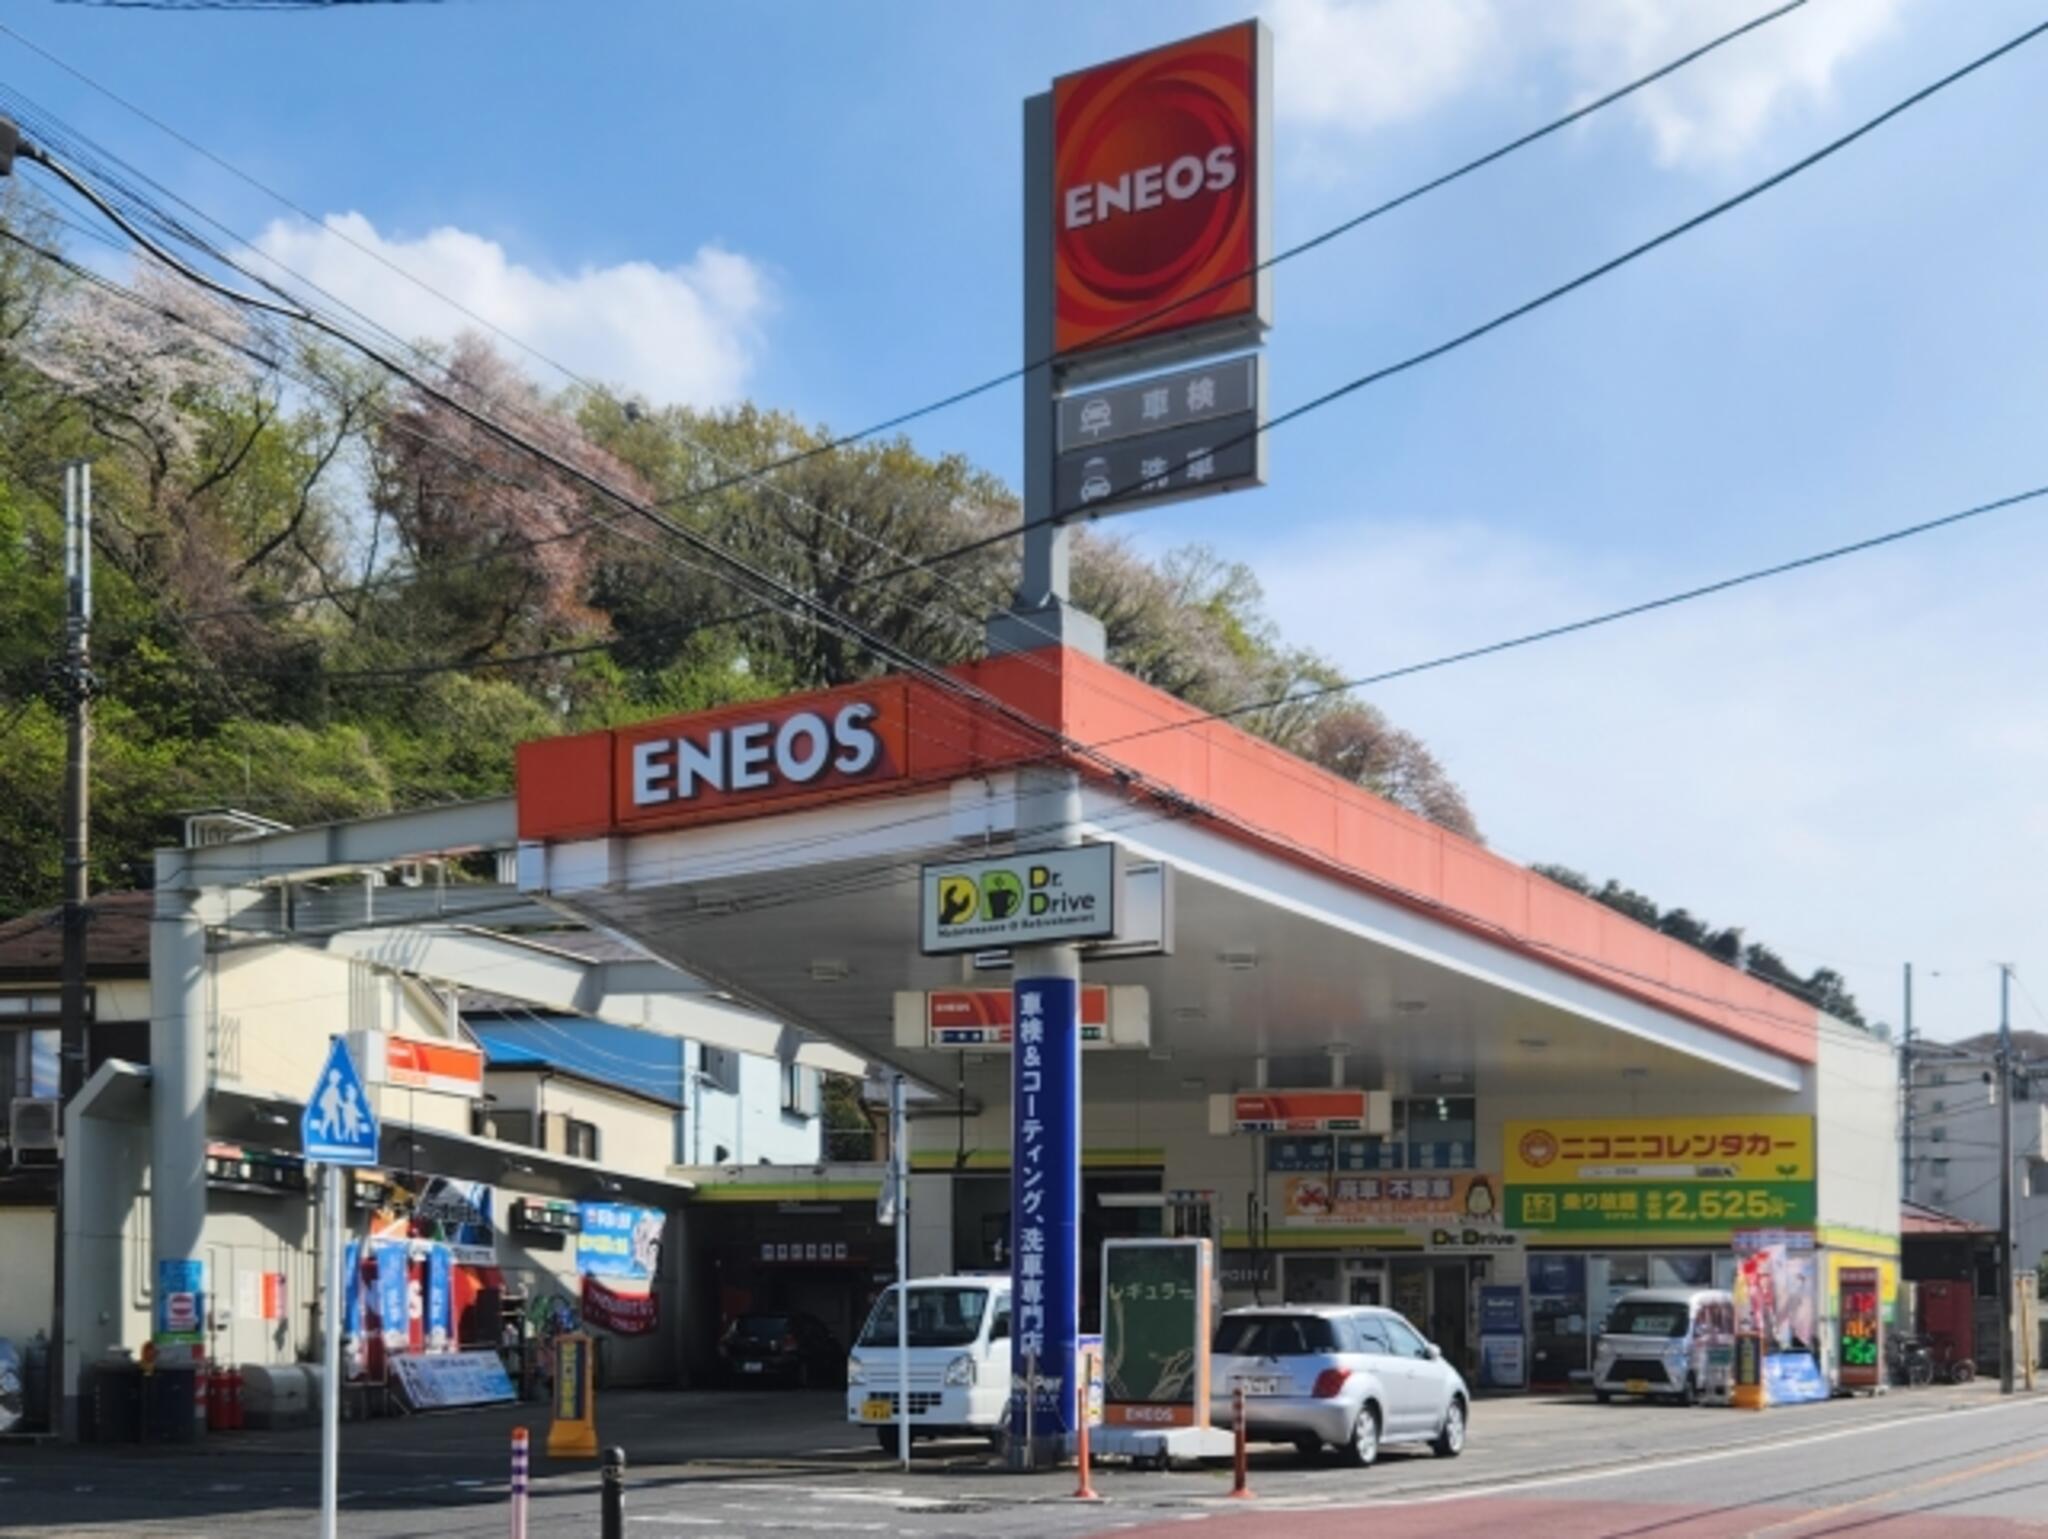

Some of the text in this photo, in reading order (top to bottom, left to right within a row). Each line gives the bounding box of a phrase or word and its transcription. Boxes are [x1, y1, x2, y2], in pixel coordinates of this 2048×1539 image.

[1064, 144, 1237, 231] ENEOS
[632, 702, 879, 806] ENEOS
[1029, 865, 1063, 890] Dr.
[1029, 893, 1096, 916] Drive
[1561, 1133, 1797, 1160] ニコニコレンタカー
[1462, 1229, 1517, 1246] Drive
[1108, 1282, 1195, 1302] レギュラー
[1125, 1407, 1174, 1422] ENEOS
